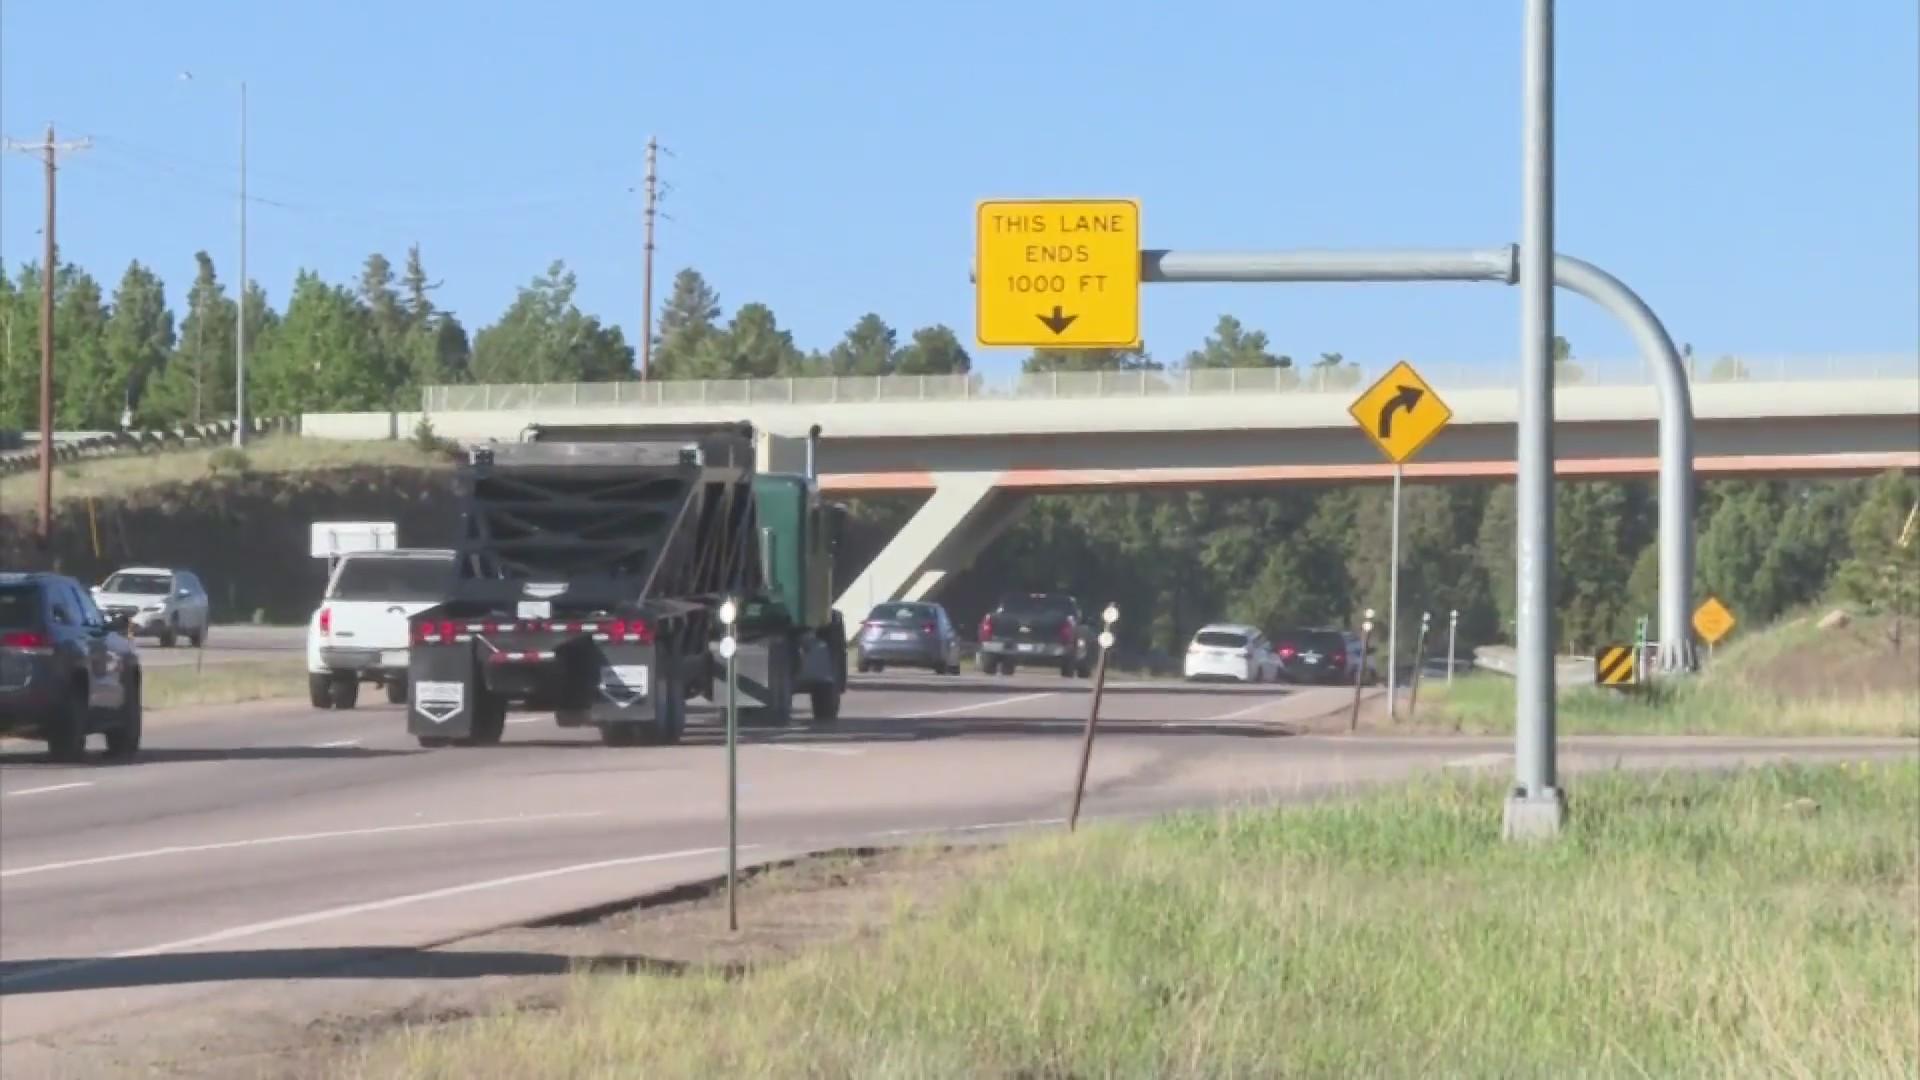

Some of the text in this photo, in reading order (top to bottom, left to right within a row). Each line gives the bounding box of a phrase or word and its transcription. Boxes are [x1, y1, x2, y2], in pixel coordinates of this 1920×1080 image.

[993, 215, 1124, 233] THIS LANE
[1025, 245, 1090, 263] ENDS
[1008, 275, 1108, 293] 1000 FT
